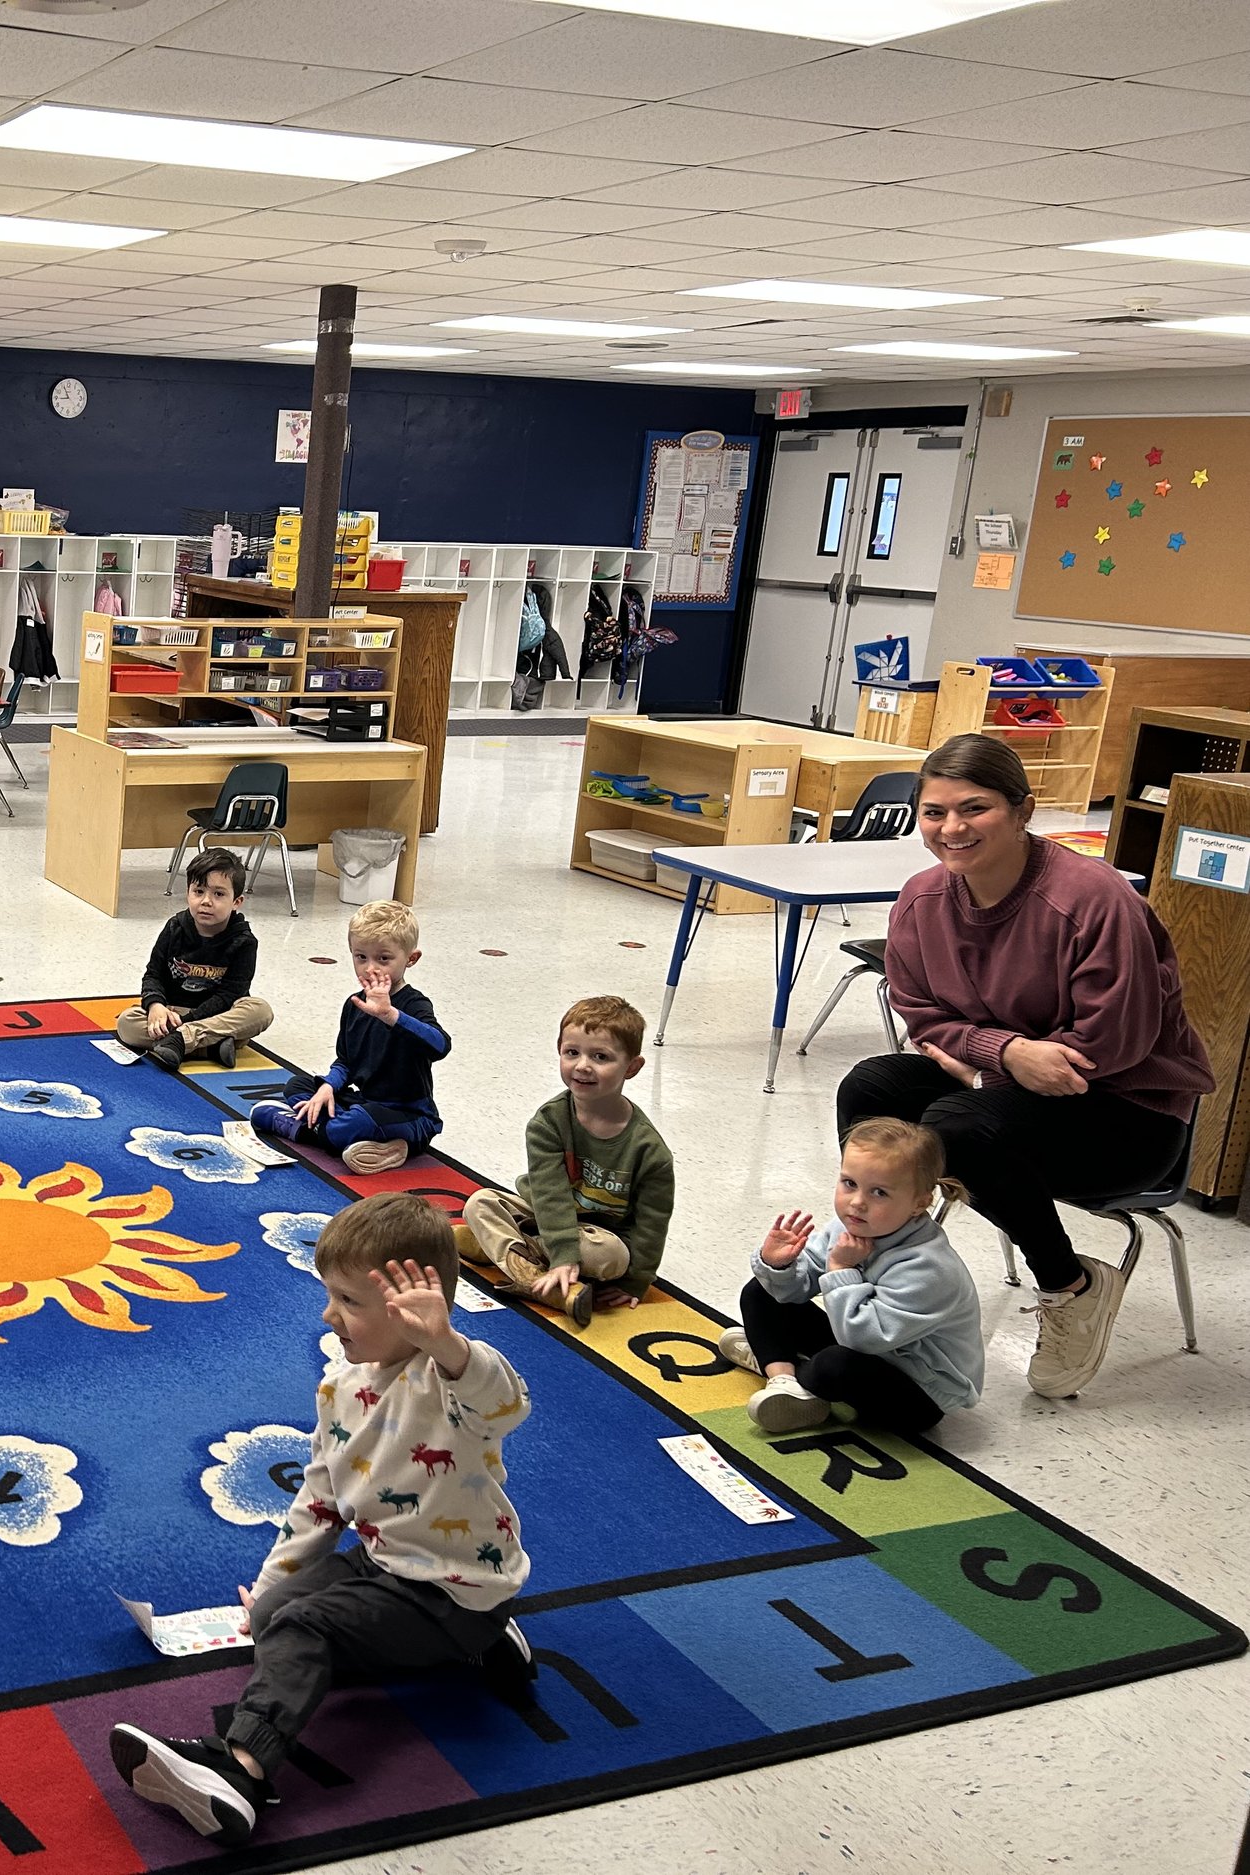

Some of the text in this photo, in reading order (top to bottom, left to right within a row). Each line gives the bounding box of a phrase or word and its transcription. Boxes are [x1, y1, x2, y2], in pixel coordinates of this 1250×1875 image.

[779, 390, 802, 416] EXIT
[1200, 838, 1225, 848] Together
[1226, 843, 1245, 852] Center
[3, 1011, 43, 1029] J
[18, 1090, 53, 1105] 5
[173, 1146, 217, 1161] 6
[628, 1331, 739, 1383] Q
[766, 1430, 908, 1495] R
[959, 1546, 1103, 1614] S
[768, 1599, 915, 1683] T
